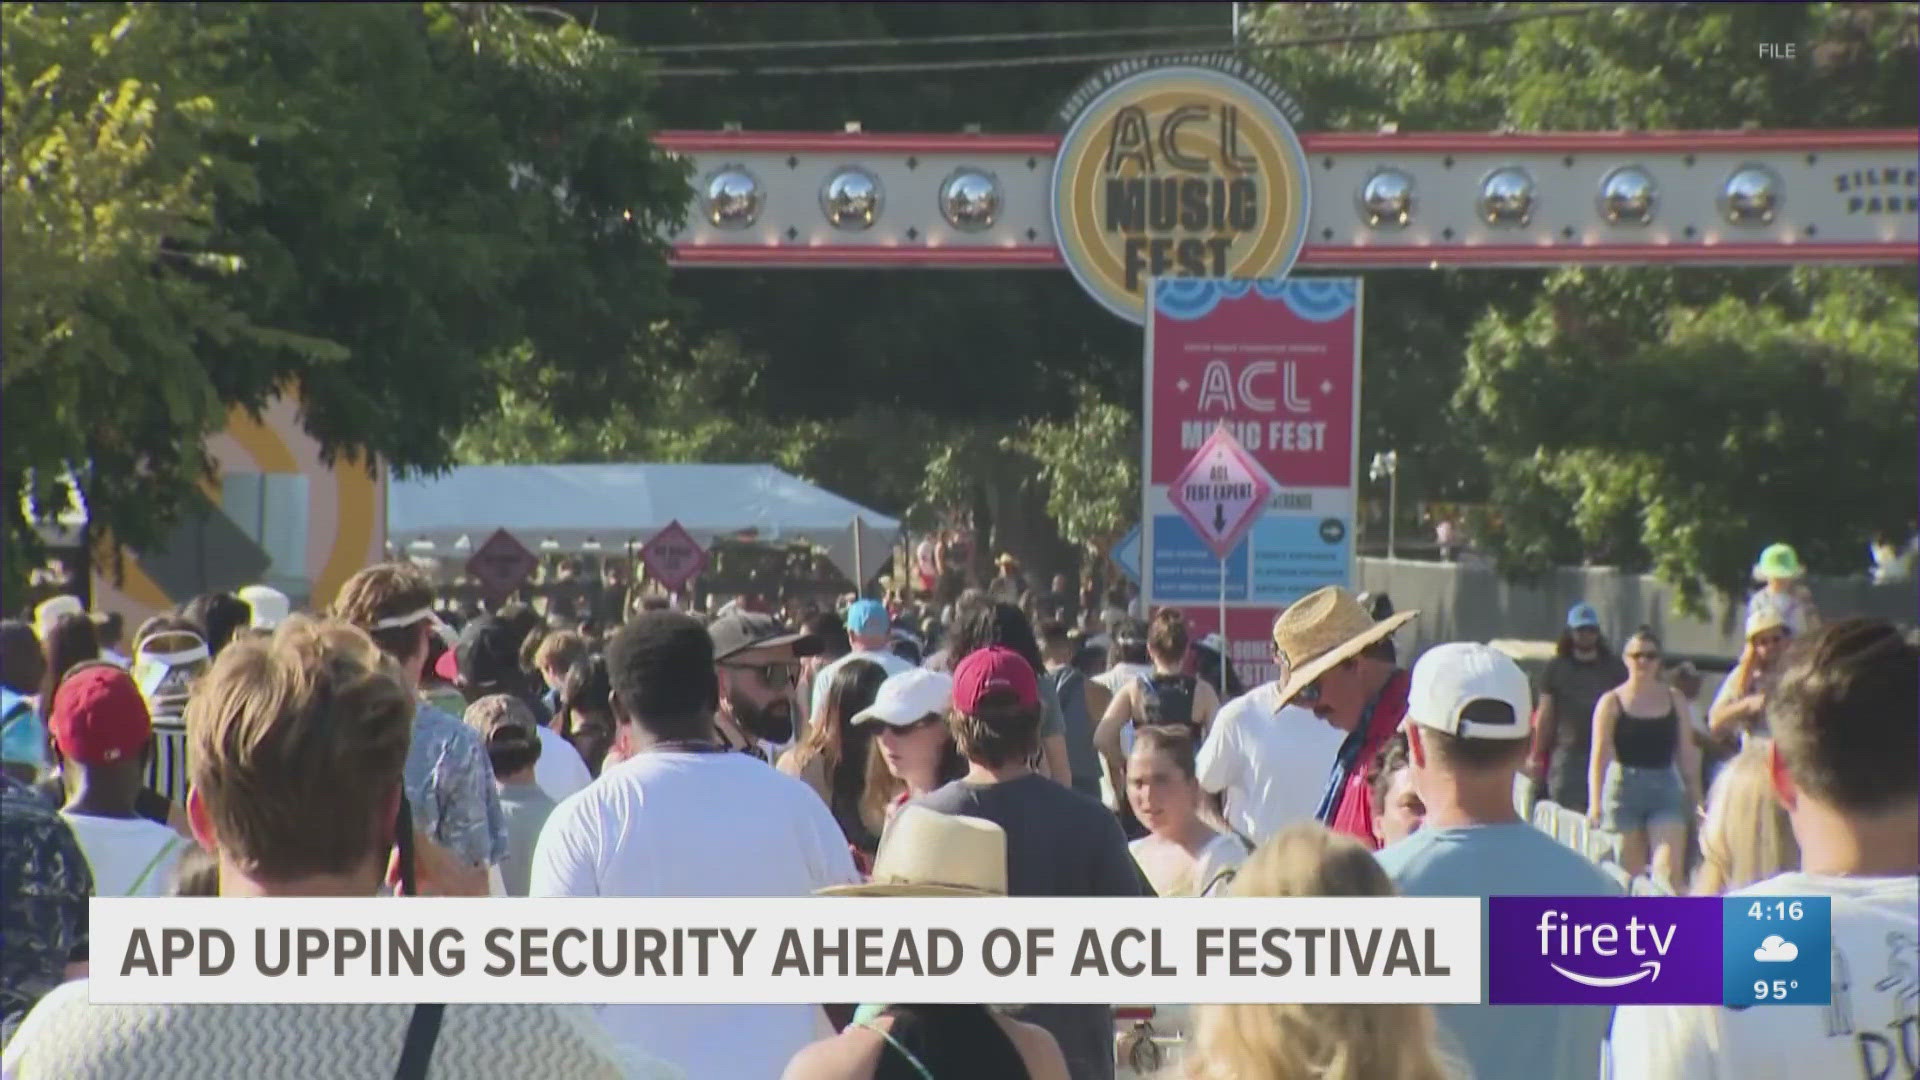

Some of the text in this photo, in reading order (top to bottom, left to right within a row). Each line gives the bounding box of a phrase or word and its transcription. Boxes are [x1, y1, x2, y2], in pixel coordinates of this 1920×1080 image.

[1104, 104, 1258, 175] ACL
[1105, 178, 1257, 233] MUSIC
[1124, 237, 1233, 291] FEST
[1197, 359, 1312, 412] ACL
[1269, 420, 1327, 451] FEST
[1186, 482, 1252, 501] FEST EXPERT
[1209, 465, 1230, 481] ACL
